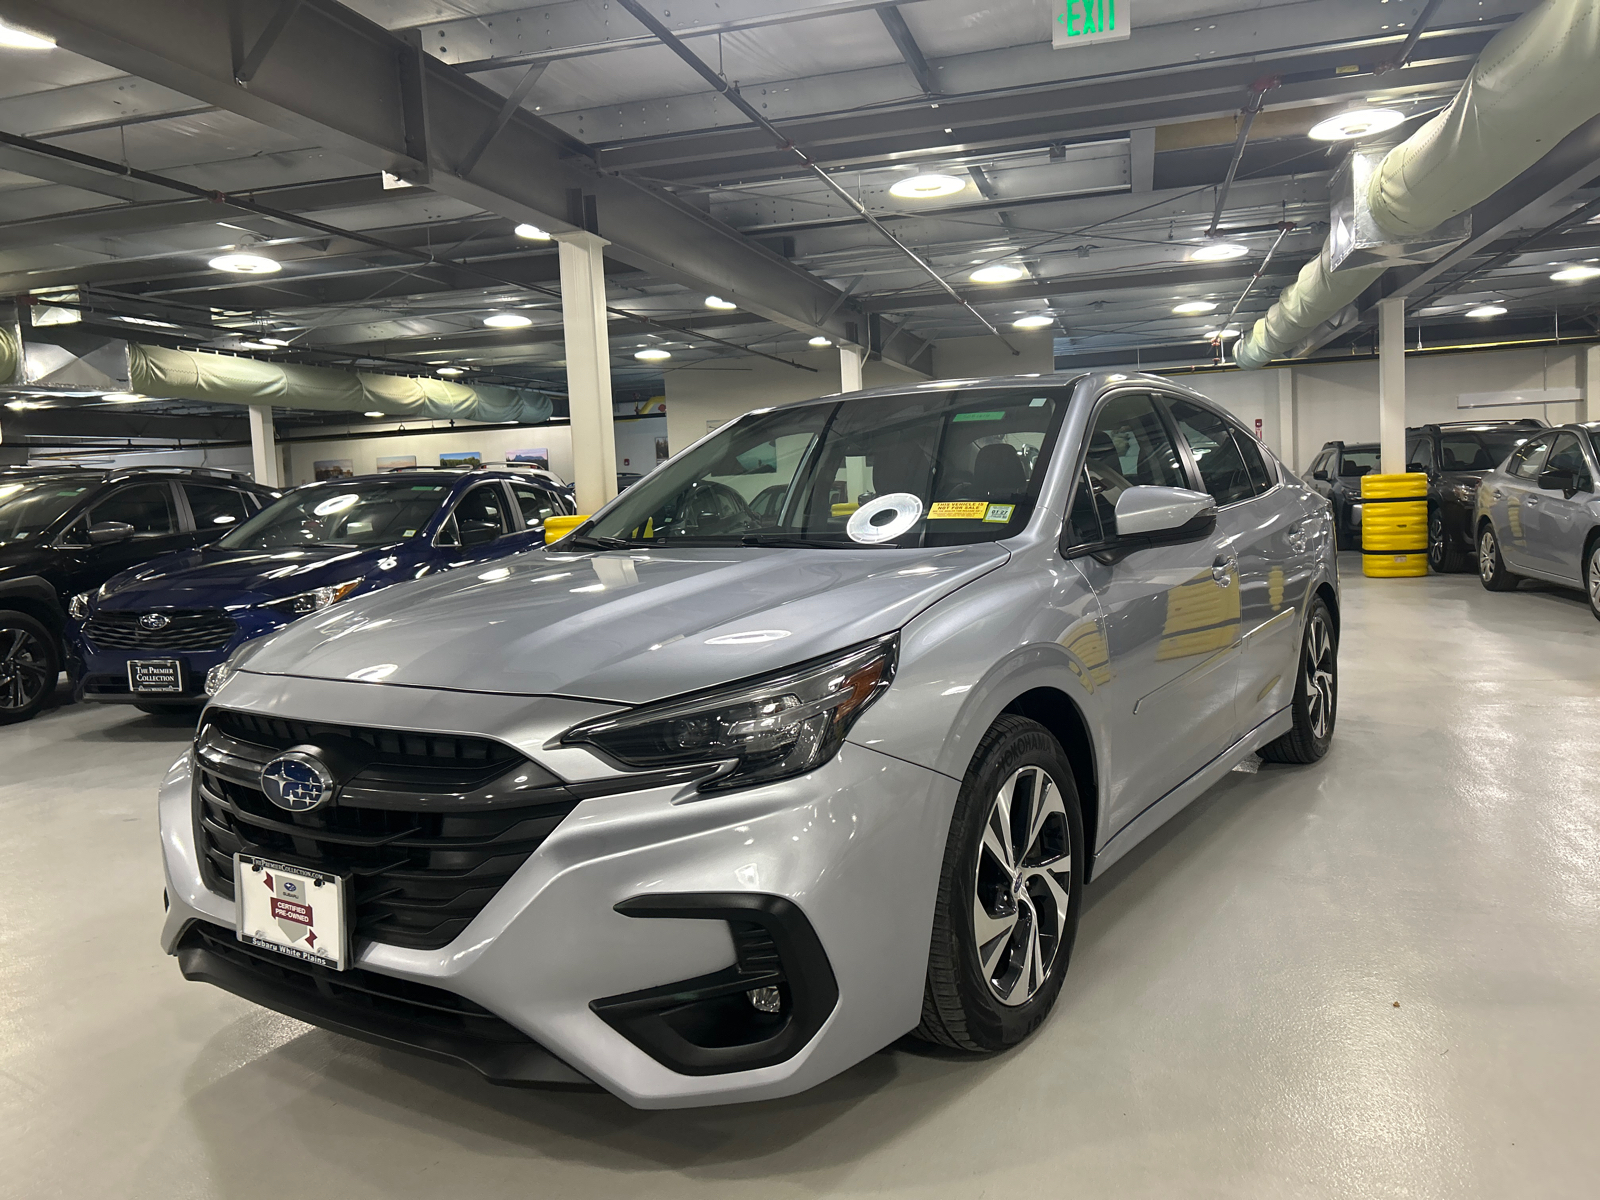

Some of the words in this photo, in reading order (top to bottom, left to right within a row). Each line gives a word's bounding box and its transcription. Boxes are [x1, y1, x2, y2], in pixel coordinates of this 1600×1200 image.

[1000, 733, 1052, 774] YOKOHAMA
[275, 908, 309, 923] PRE-OWNED
[277, 902, 306, 914] CERTIFIED
[252, 938, 277, 952] Subaru
[279, 945, 301, 958] White
[302, 953, 326, 965] Plains
